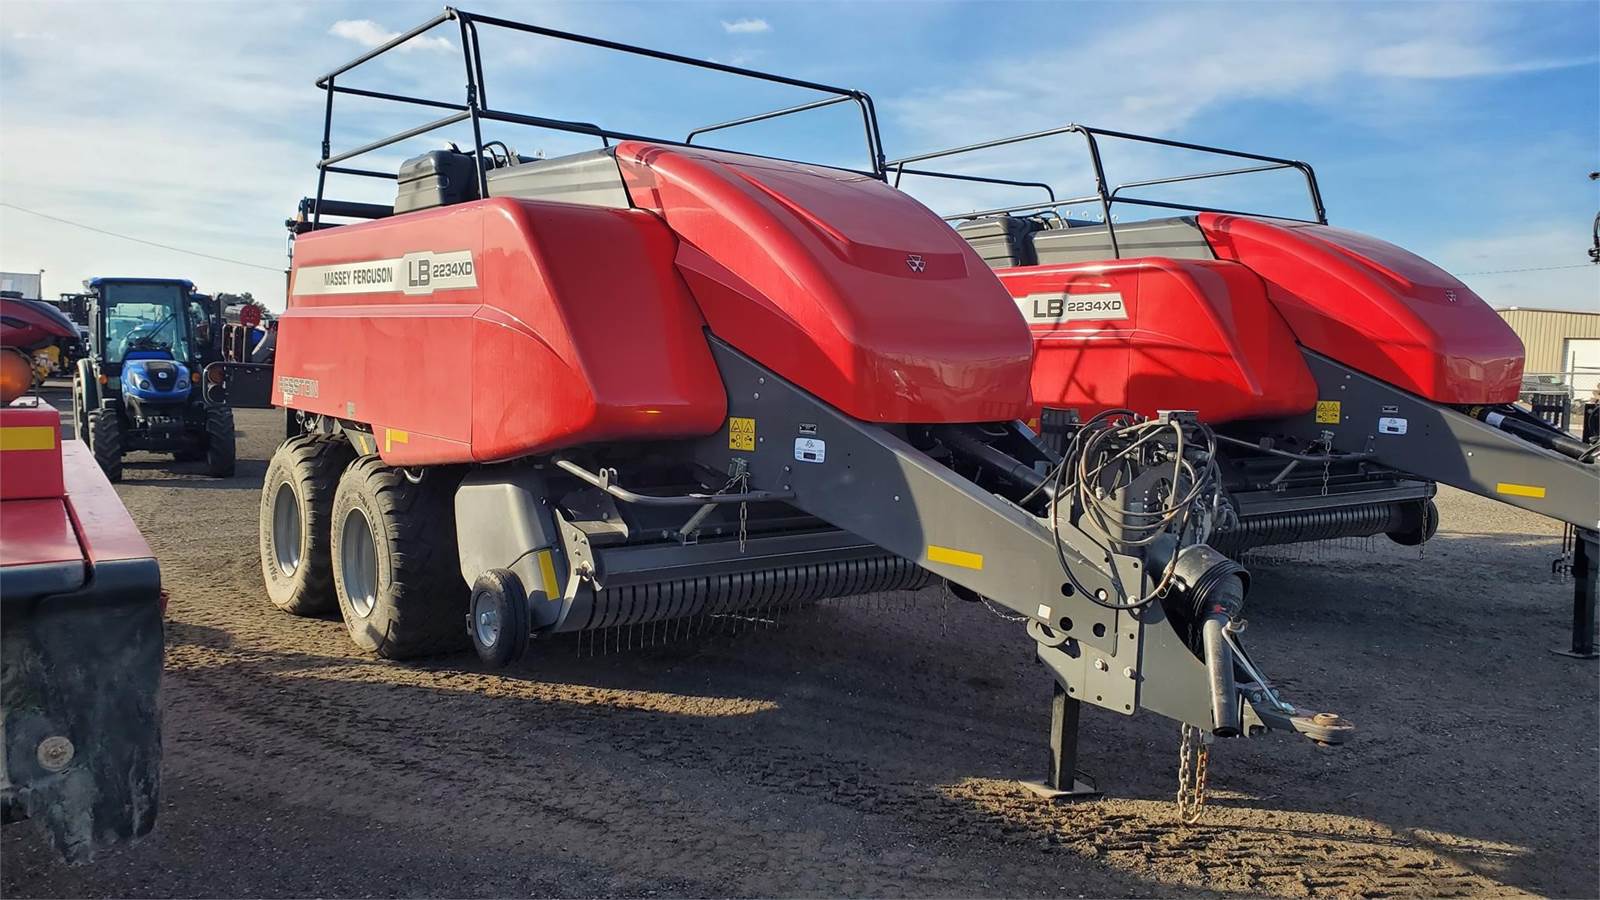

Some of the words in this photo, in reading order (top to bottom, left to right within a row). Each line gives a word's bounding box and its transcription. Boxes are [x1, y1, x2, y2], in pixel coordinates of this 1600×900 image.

[324, 272, 351, 287] MASSEY
[353, 266, 393, 284] FERGUSON
[408, 259, 430, 286] LB
[432, 261, 473, 278] 2234XD
[1033, 299, 1063, 318] LB
[1067, 300, 1122, 312] 2234XD
[279, 376, 319, 398] HESSTON
